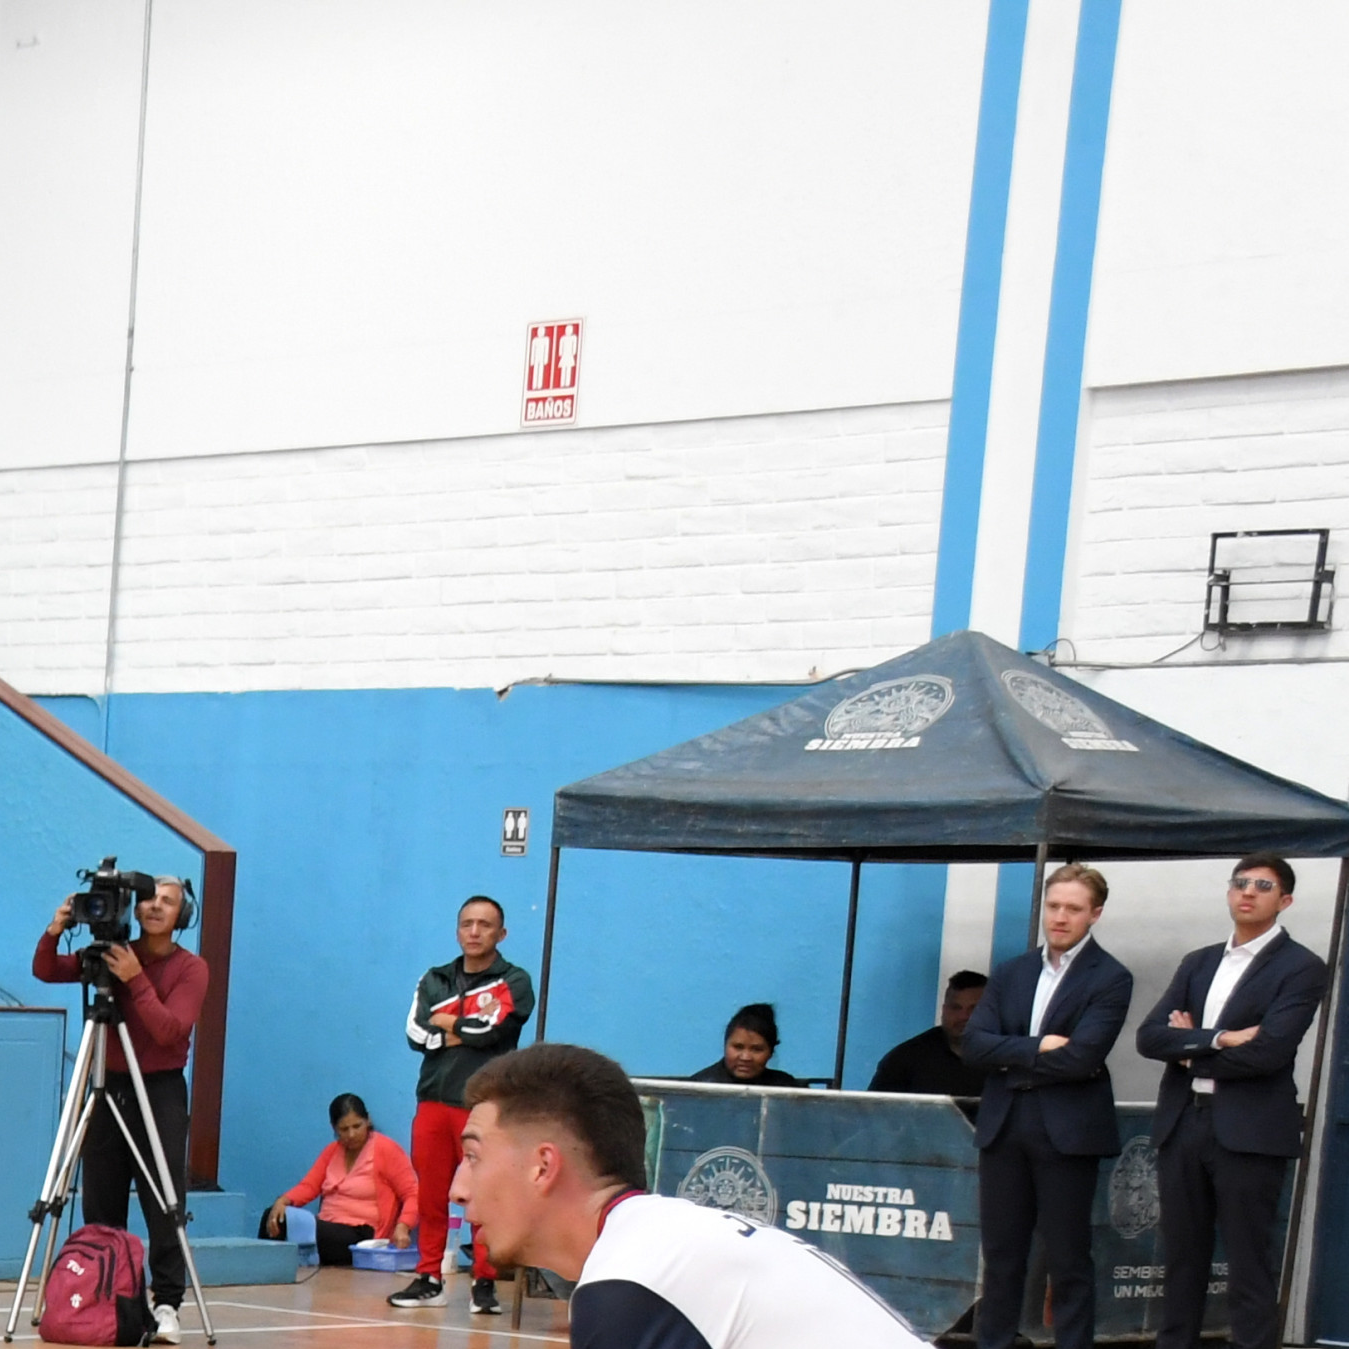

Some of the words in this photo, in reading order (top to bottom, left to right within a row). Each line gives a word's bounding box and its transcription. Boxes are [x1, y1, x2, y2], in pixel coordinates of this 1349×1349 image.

[526, 397, 572, 420] BAÑOS
[804, 736, 922, 750] SIEMBRA
[826, 1183, 915, 1205] NUESTRA
[786, 1200, 953, 1241] SIEMBRA
[1113, 1265, 1165, 1279] SEMBRE
[1114, 1285, 1132, 1298] UN
